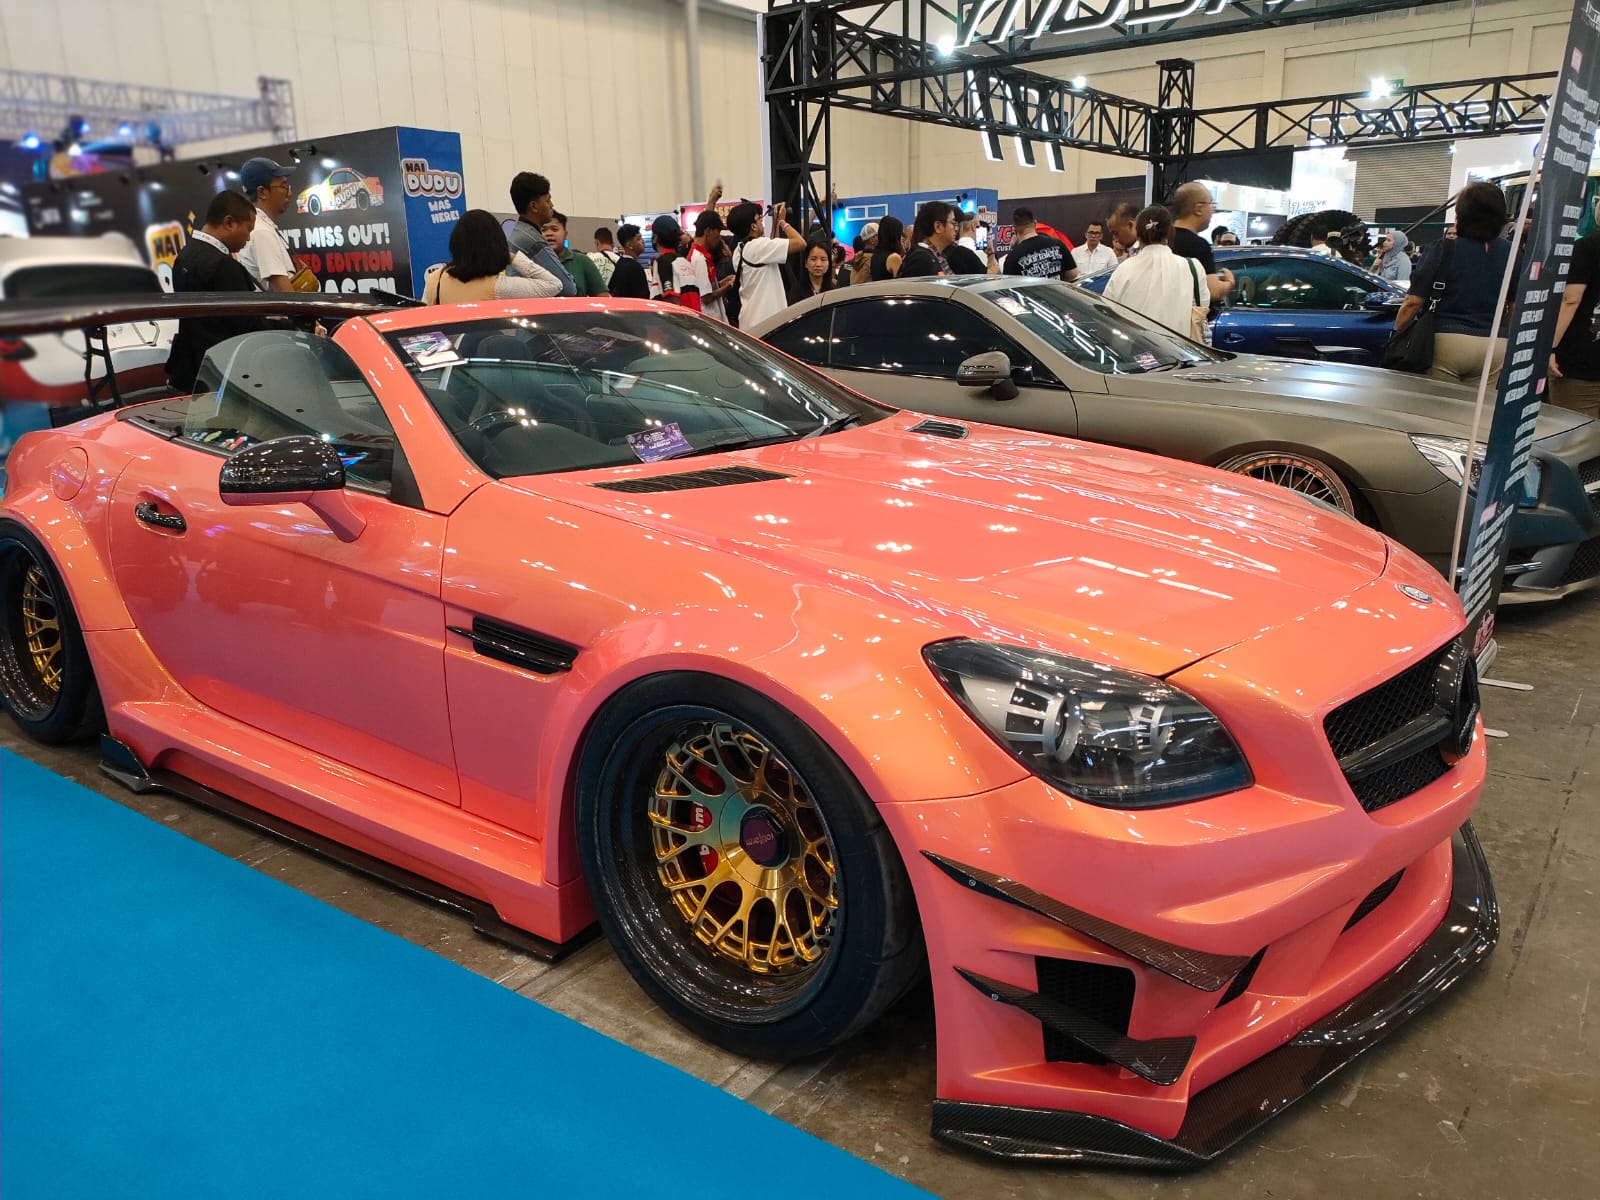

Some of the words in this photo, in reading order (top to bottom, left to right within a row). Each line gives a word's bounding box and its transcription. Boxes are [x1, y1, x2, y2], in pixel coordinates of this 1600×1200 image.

[405, 163, 425, 172] HAI
[408, 174, 458, 193] DUDU
[428, 200, 451, 212] WAS
[431, 210, 460, 224] HERE!
[305, 226, 345, 249] MISS
[348, 222, 391, 247] OUT!
[154, 233, 181, 259] HAI
[325, 250, 393, 273] EDITION
